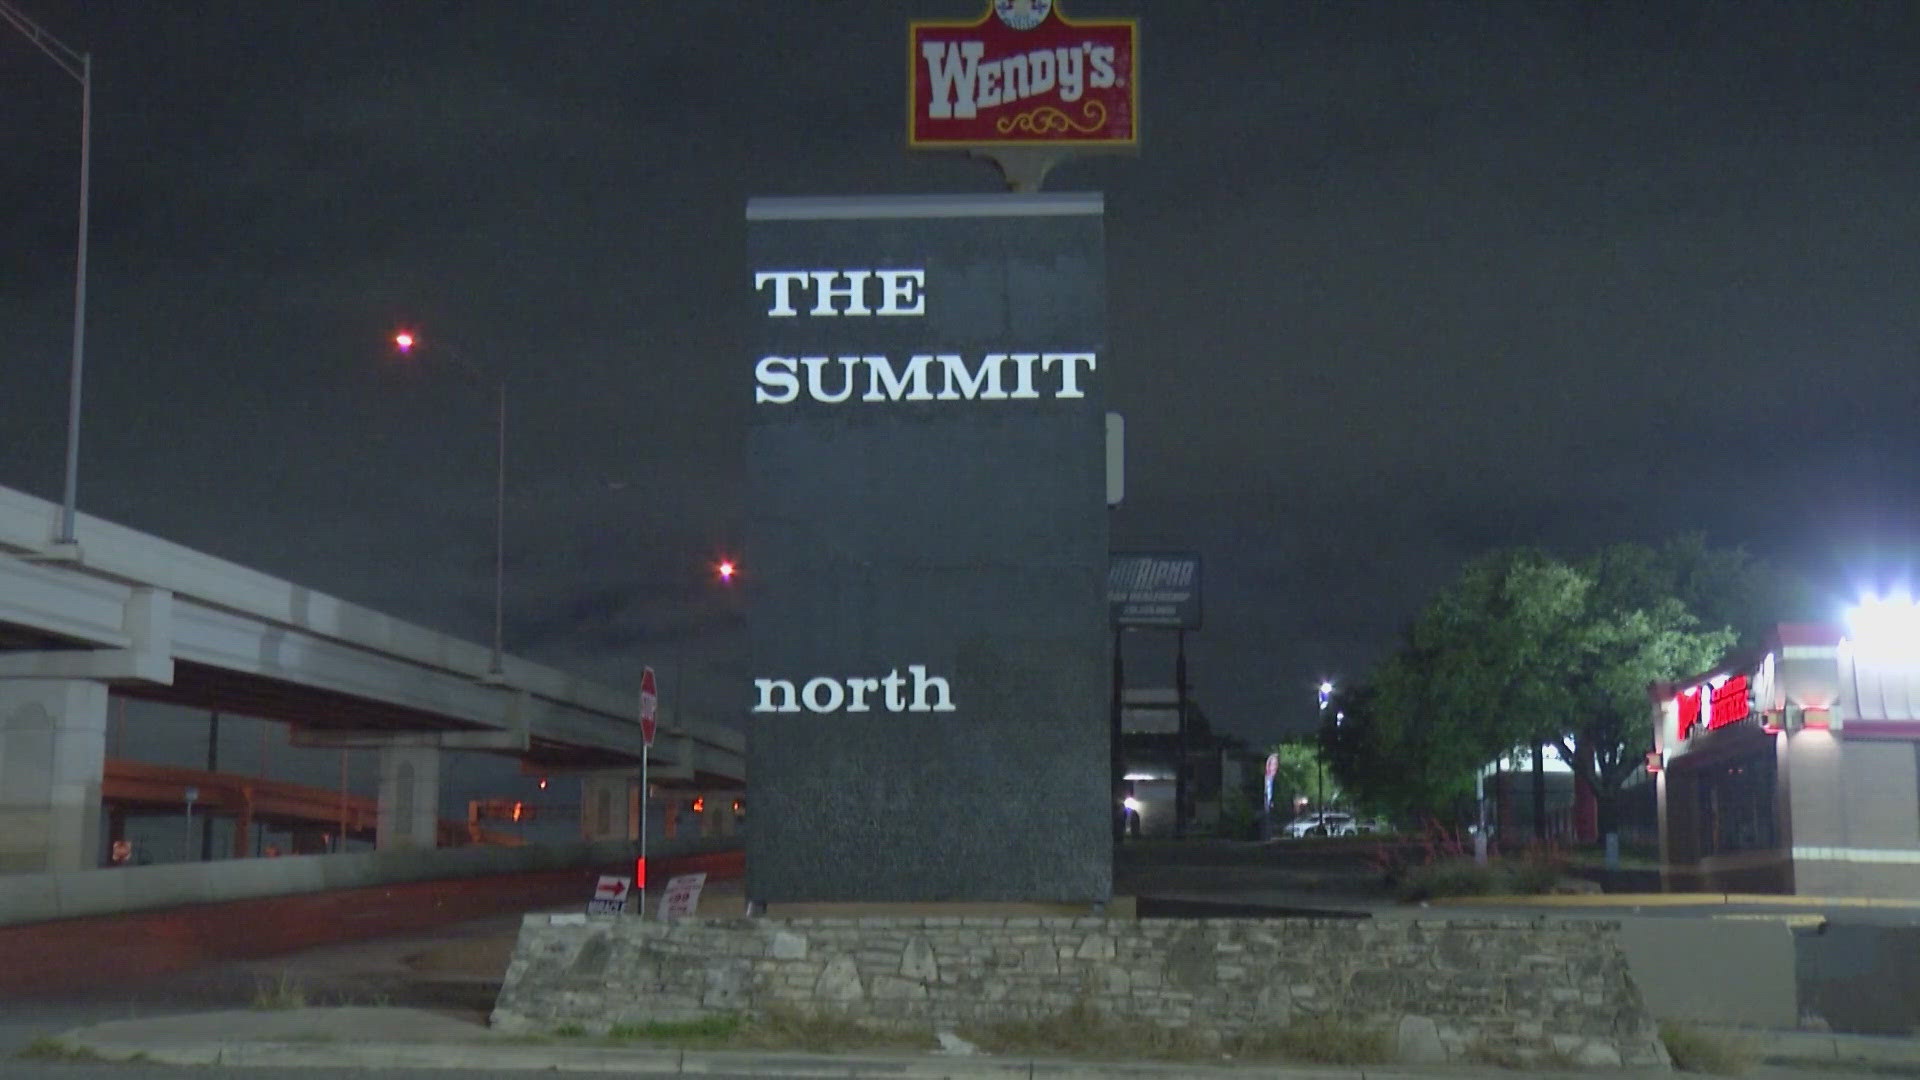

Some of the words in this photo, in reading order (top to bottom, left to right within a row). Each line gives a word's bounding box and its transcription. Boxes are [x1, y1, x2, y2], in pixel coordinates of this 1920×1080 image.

[755, 268, 926, 317] THE
[755, 352, 1097, 404] SUMMIT
[754, 664, 956, 713] north
